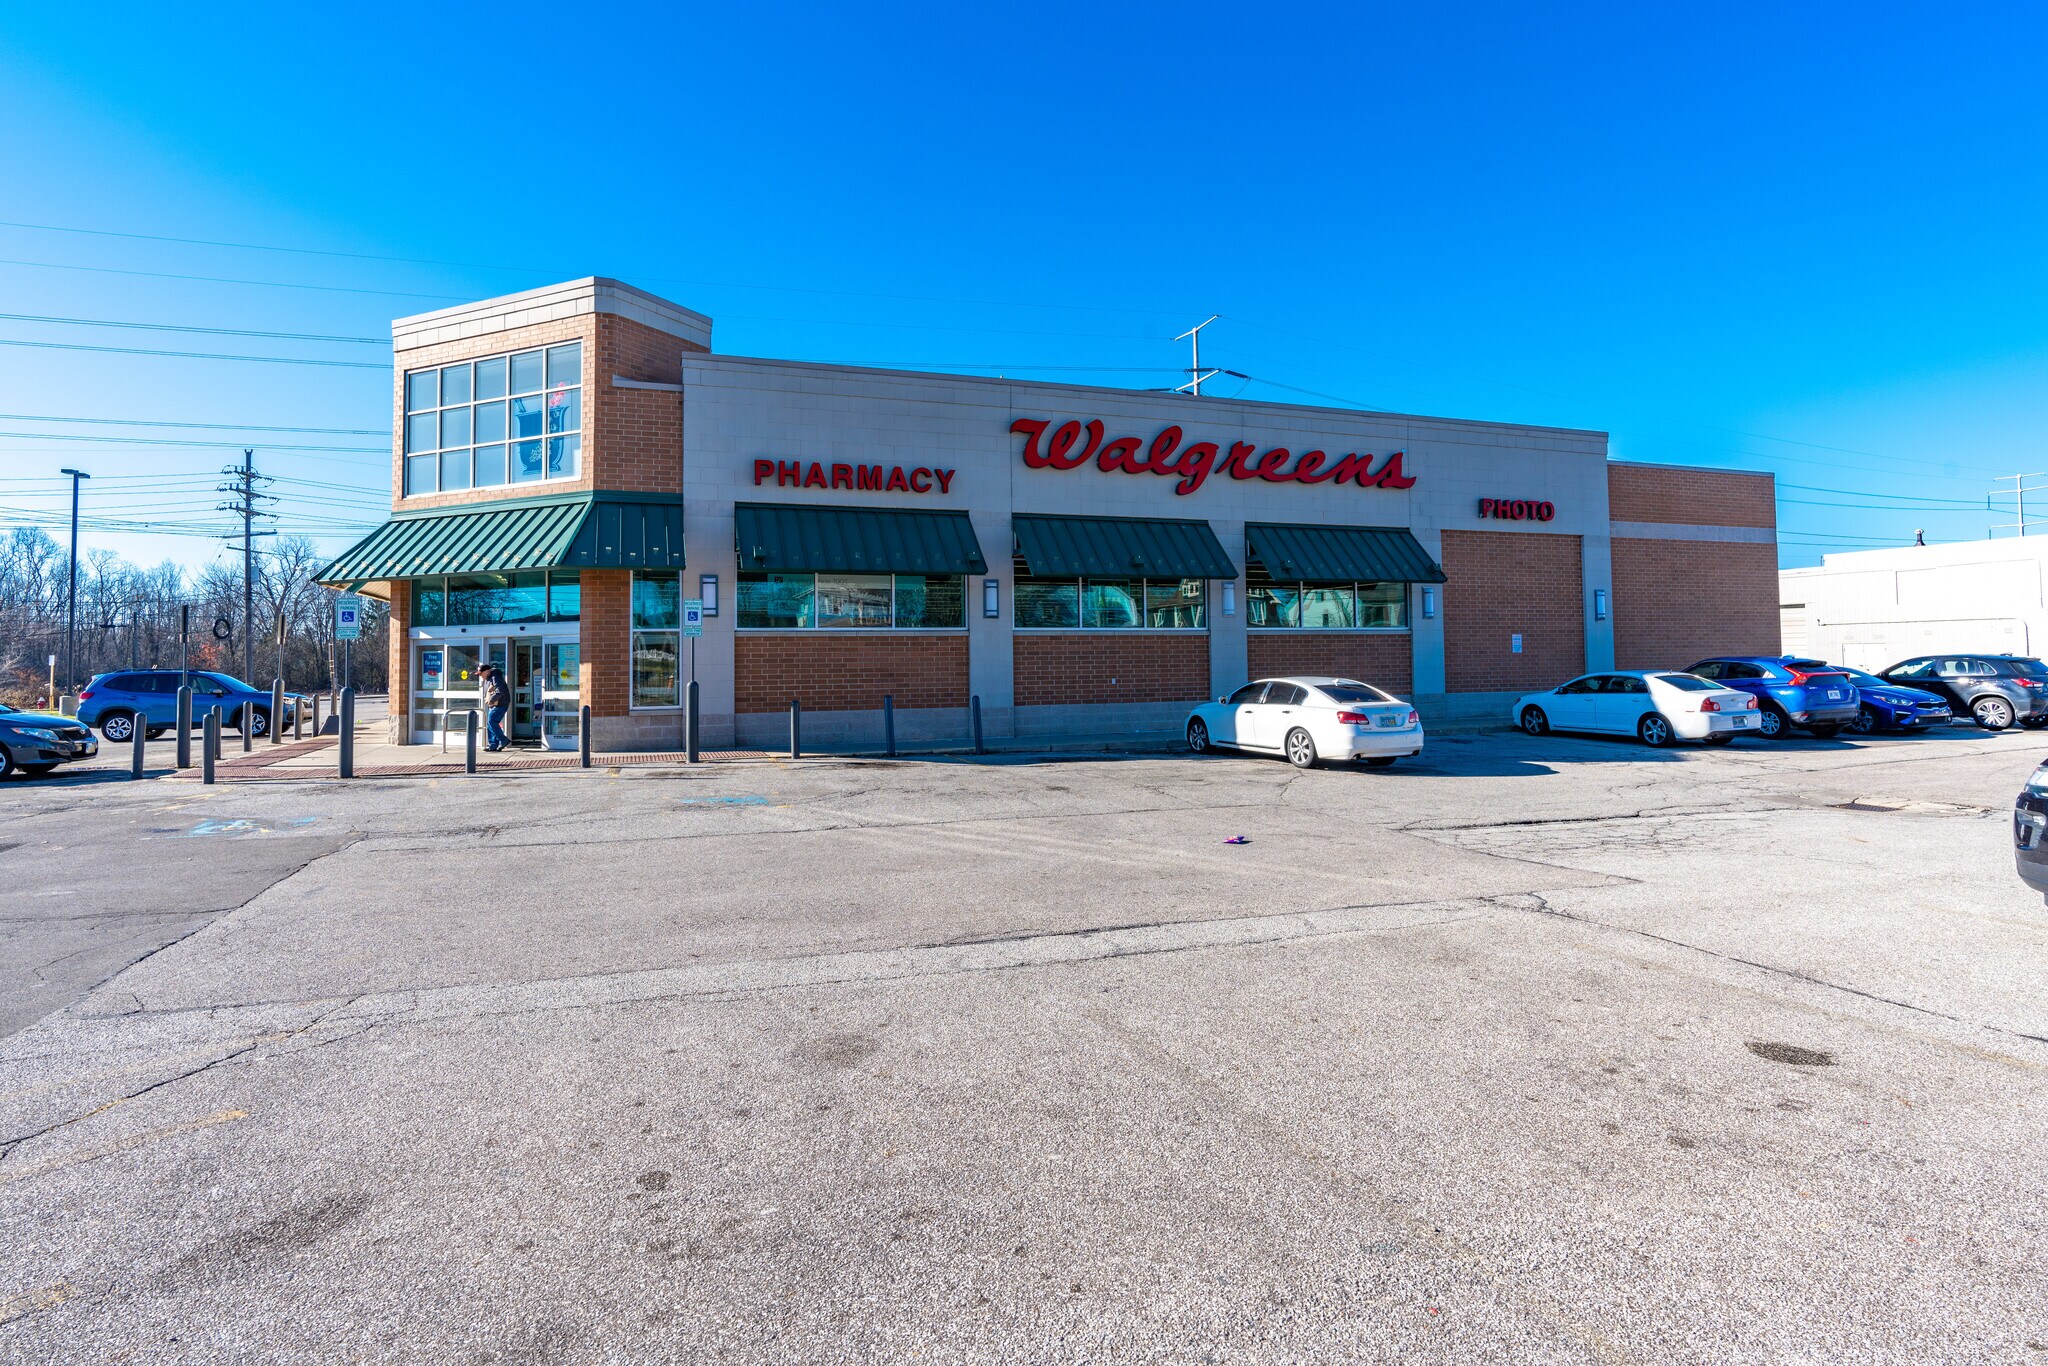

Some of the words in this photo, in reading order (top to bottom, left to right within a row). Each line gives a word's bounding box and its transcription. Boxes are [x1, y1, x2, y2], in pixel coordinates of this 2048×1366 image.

[1009, 418, 1418, 496] Walgreens
[754, 459, 956, 494] PHARMACY
[1479, 498, 1556, 521] PHOTO
